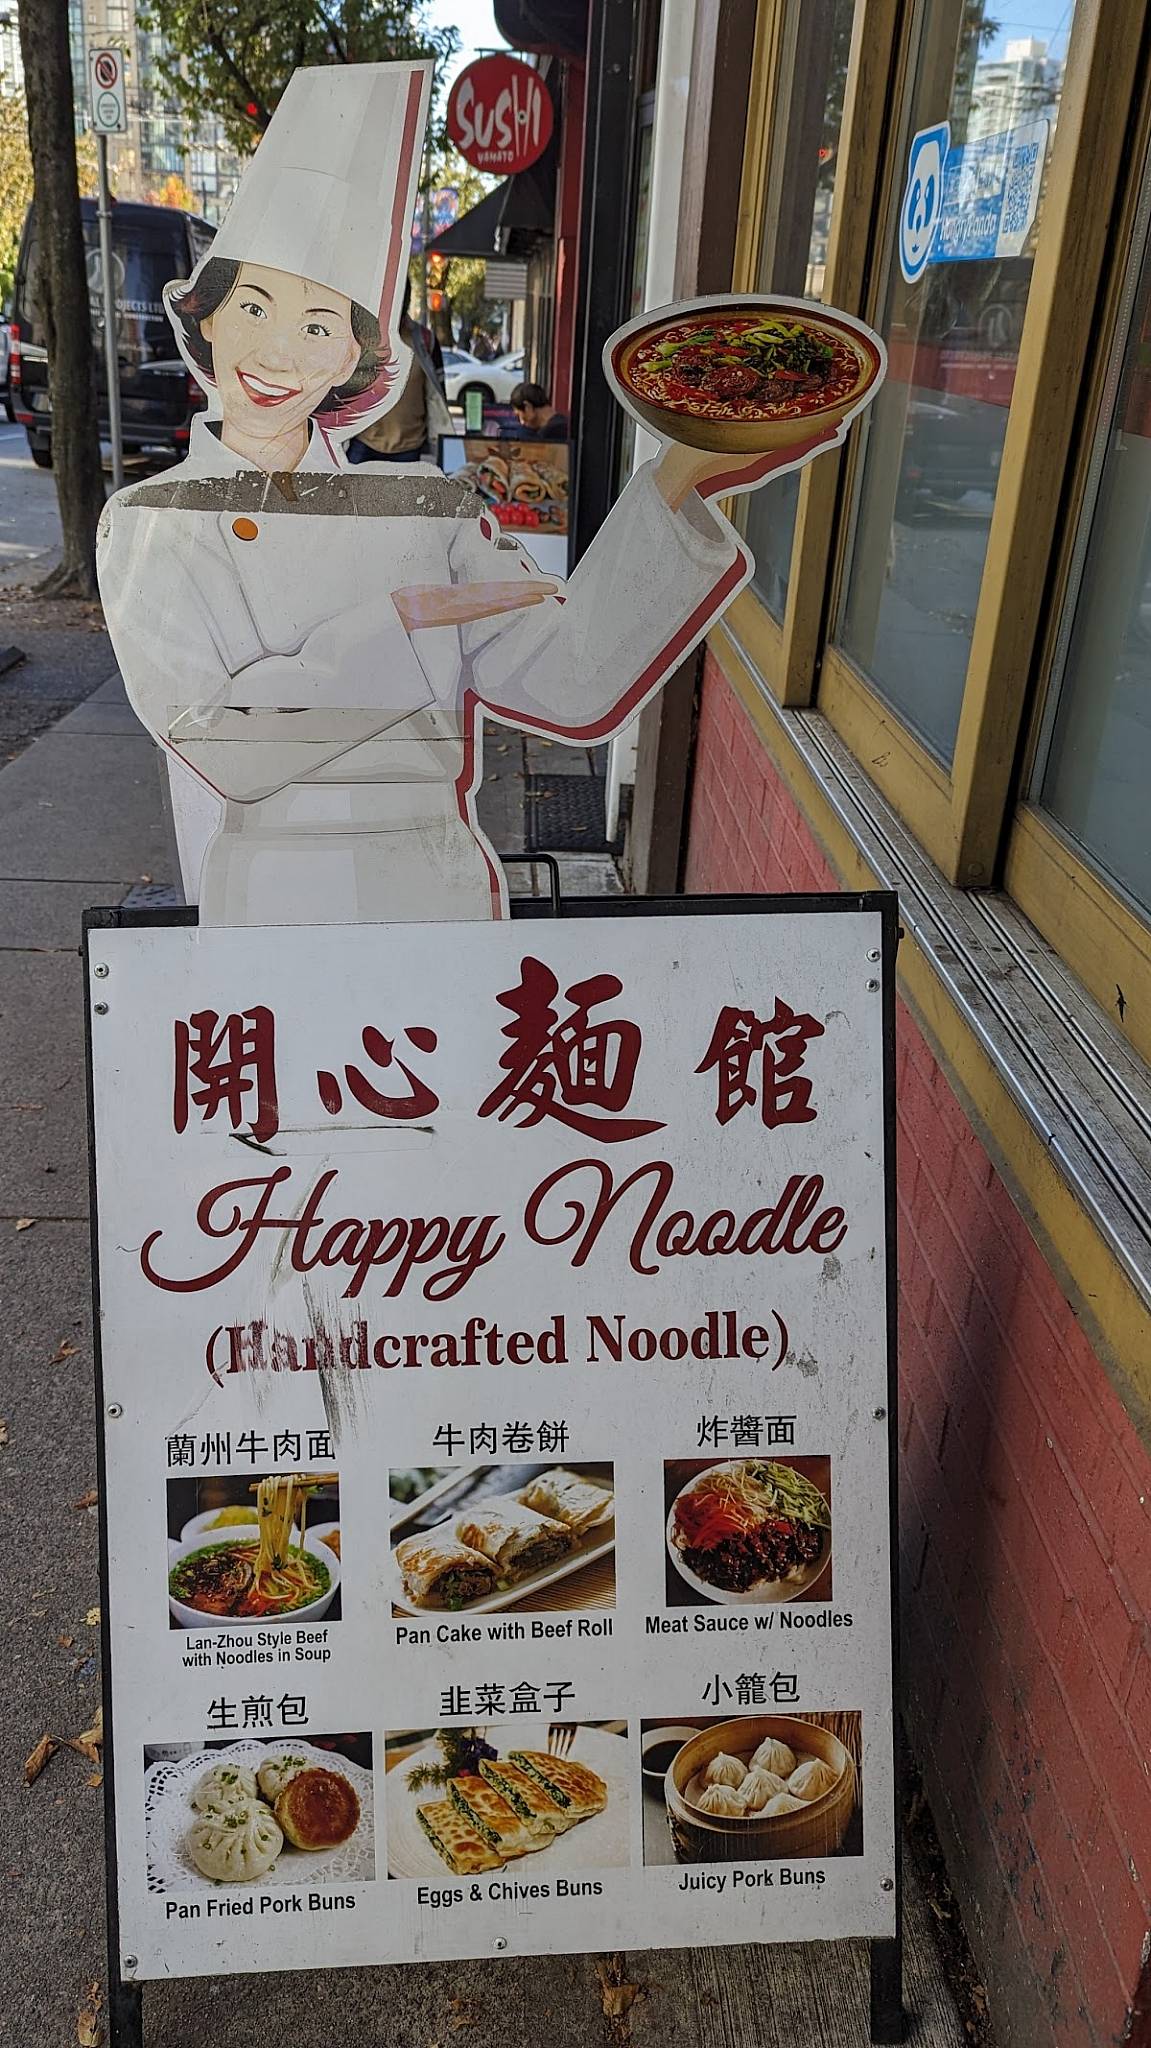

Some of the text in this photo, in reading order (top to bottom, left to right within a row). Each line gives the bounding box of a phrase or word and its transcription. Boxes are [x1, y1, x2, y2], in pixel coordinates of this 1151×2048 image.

[456, 74, 541, 157] SUSHI
[141, 1158, 848, 1301] Happy Noodle
[206, 1309, 789, 1388] (Handcrafted Noodle)
[167, 1429, 336, 1467] 蘭州牛肉面
[432, 1420, 570, 1456] 牛肉卷餅
[696, 1415, 797, 1448] 炸醬面
[396, 1618, 614, 1645] Pan Cake with Beef Roll
[645, 1610, 854, 1634] Meat Sauce w/ Noodles
[186, 1629, 329, 1650] Lan-Zhou Style Beef
[182, 1647, 331, 1667] with Noodles in Soup
[439, 1681, 576, 1717] 韭菜盒子
[701, 1672, 801, 1705] 小籠包
[206, 1693, 309, 1729] 生煎包
[417, 1878, 604, 1908] Eggs & Chives Buns
[677, 1867, 826, 1893] Juicy Pork Buns
[165, 1892, 356, 1919] Pan Fried Pork Buns
